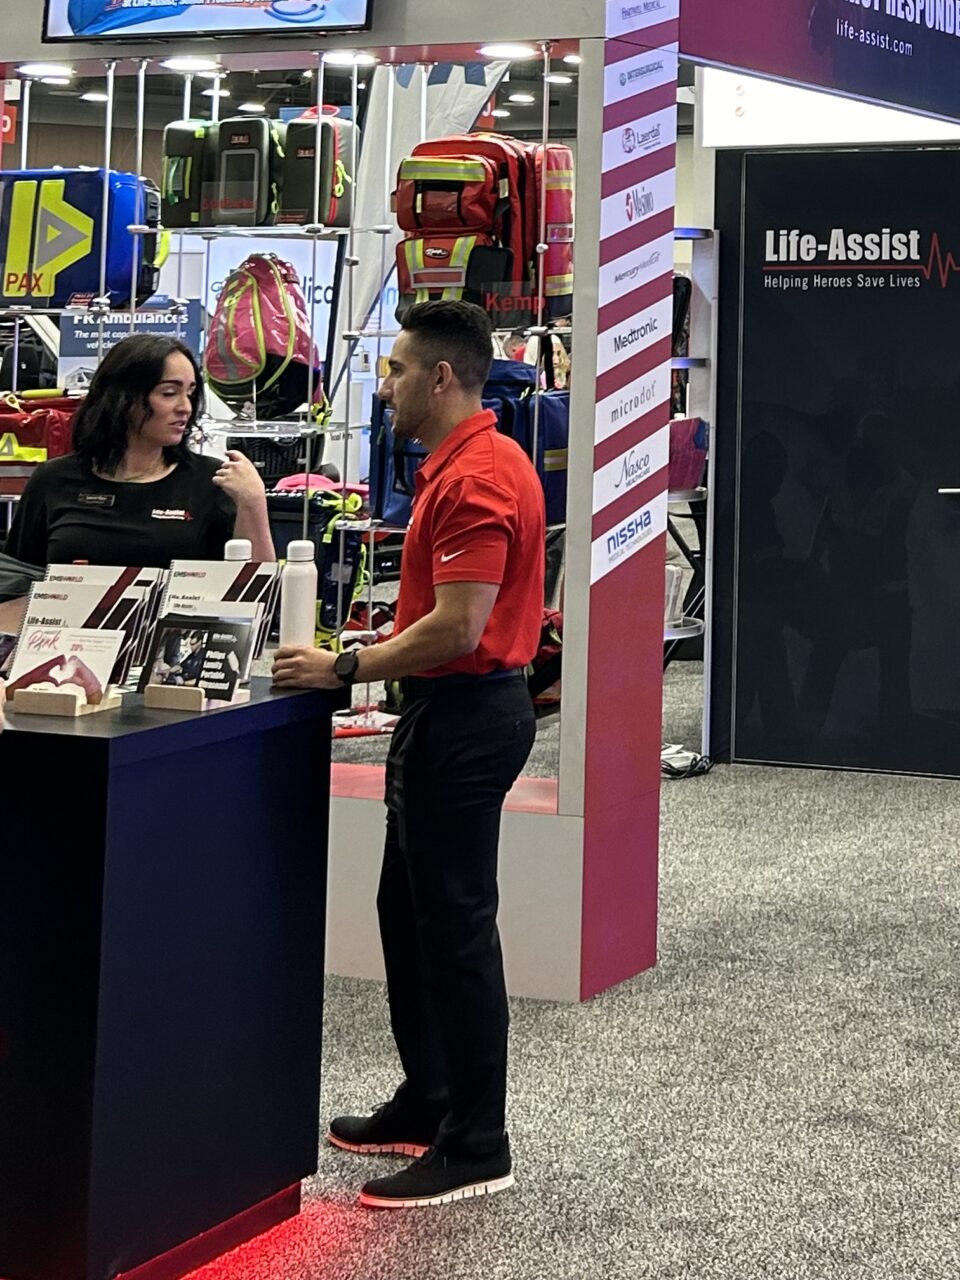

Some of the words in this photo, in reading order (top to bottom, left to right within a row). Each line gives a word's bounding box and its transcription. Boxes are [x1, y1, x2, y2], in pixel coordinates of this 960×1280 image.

[836, 18, 913, 56] life-assist.com
[765, 228, 921, 263] Life-Assist
[6, 272, 43, 293] PAX
[764, 274, 809, 290] Helping
[813, 274, 853, 288] Heroes
[857, 273, 886, 287] Save
[889, 274, 921, 287] Lives
[485, 293, 547, 315] Kemp
[74, 330, 89, 339] The
[90, 330, 110, 339] mst
[613, 317, 658, 353] Medtronic
[611, 382, 656, 422] microdot
[27, 615, 62, 626] Life-Assist
